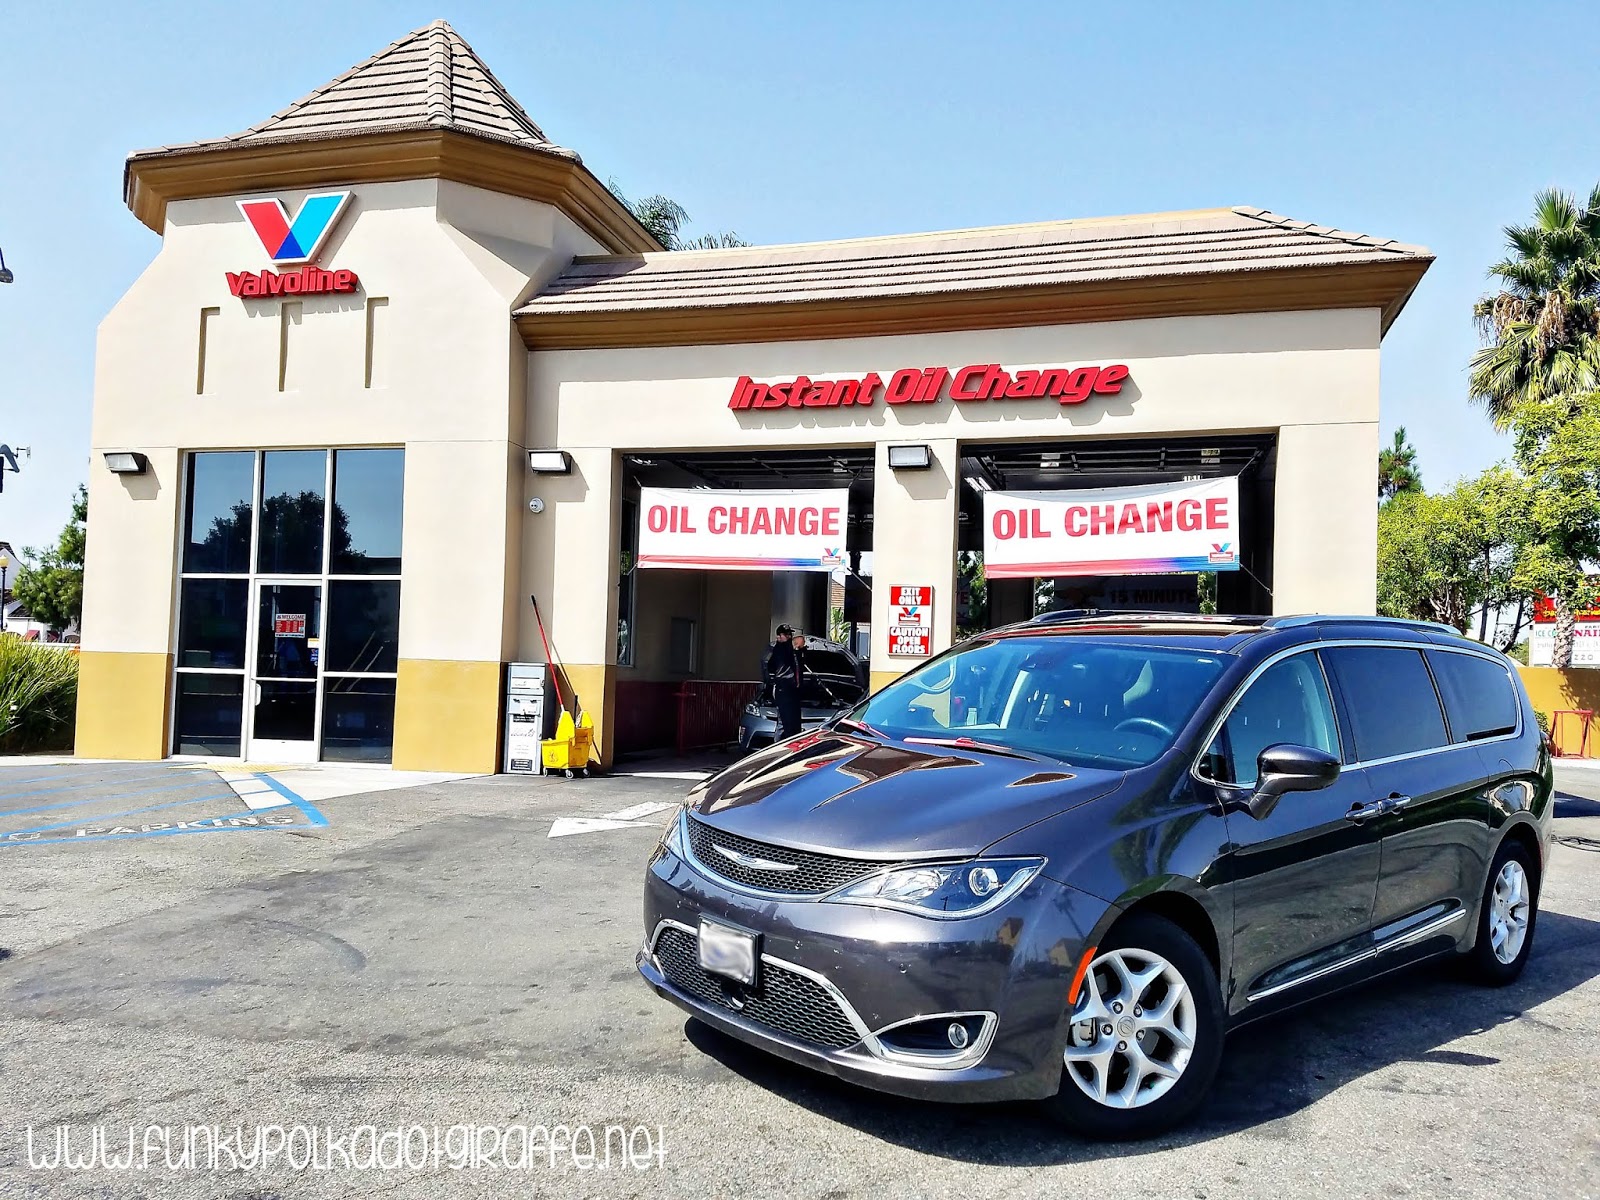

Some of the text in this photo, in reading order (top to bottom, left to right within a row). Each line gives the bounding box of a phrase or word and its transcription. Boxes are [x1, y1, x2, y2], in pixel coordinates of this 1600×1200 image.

[225, 265, 358, 299] Valvoline
[727, 363, 1129, 411] Instant Oil Change
[647, 504, 840, 536] OIL CHANGE
[992, 497, 1230, 541] OIL CHANGE
[901, 587, 921, 596] EXIT
[898, 595, 922, 605] ONLY
[890, 627, 929, 636] CAUTION
[1573, 629, 1600, 637] NAI
[897, 636, 921, 645] OPEN
[892, 645, 925, 654] FLOORS
[76, 815, 295, 837] PARKING
